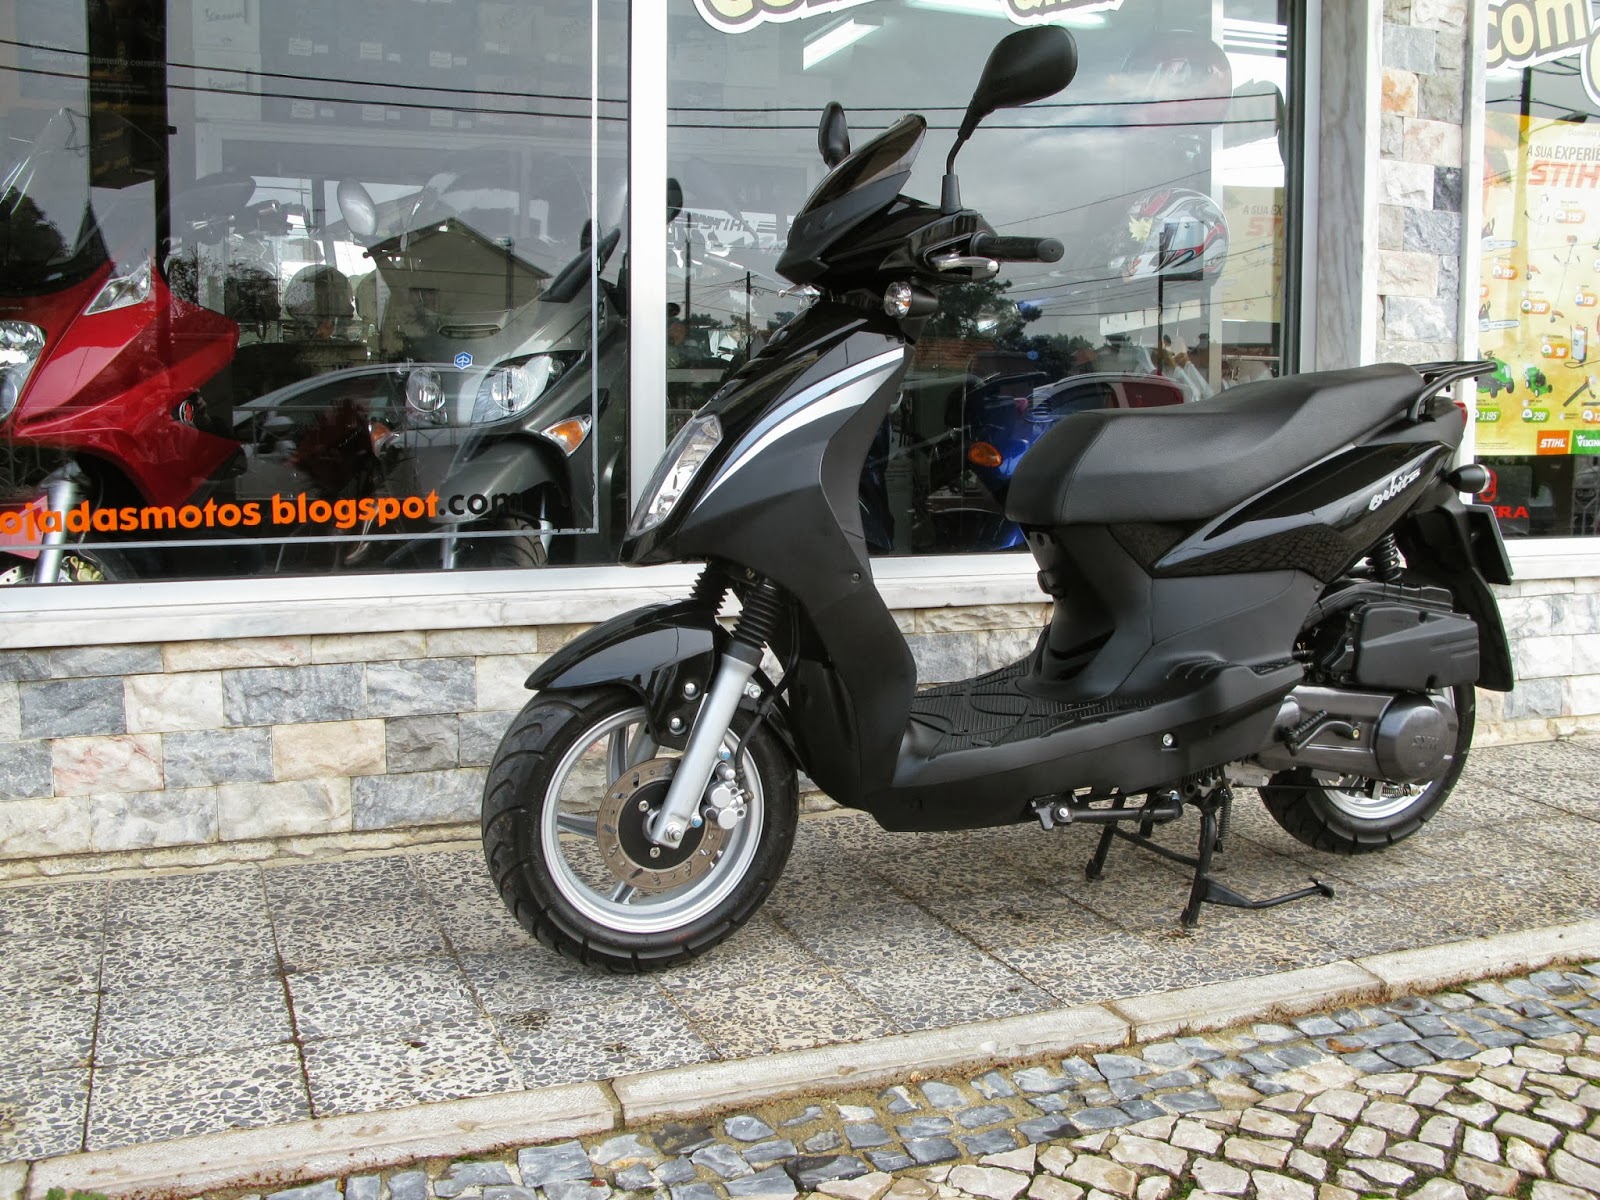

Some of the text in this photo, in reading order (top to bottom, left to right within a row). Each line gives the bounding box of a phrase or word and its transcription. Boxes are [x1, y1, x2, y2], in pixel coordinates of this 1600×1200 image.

[1526, 144, 1534, 157] A
[1534, 145, 1553, 159] SUA
[1250, 205, 1269, 216] SUA
[1539, 437, 1567, 448] STIHL
